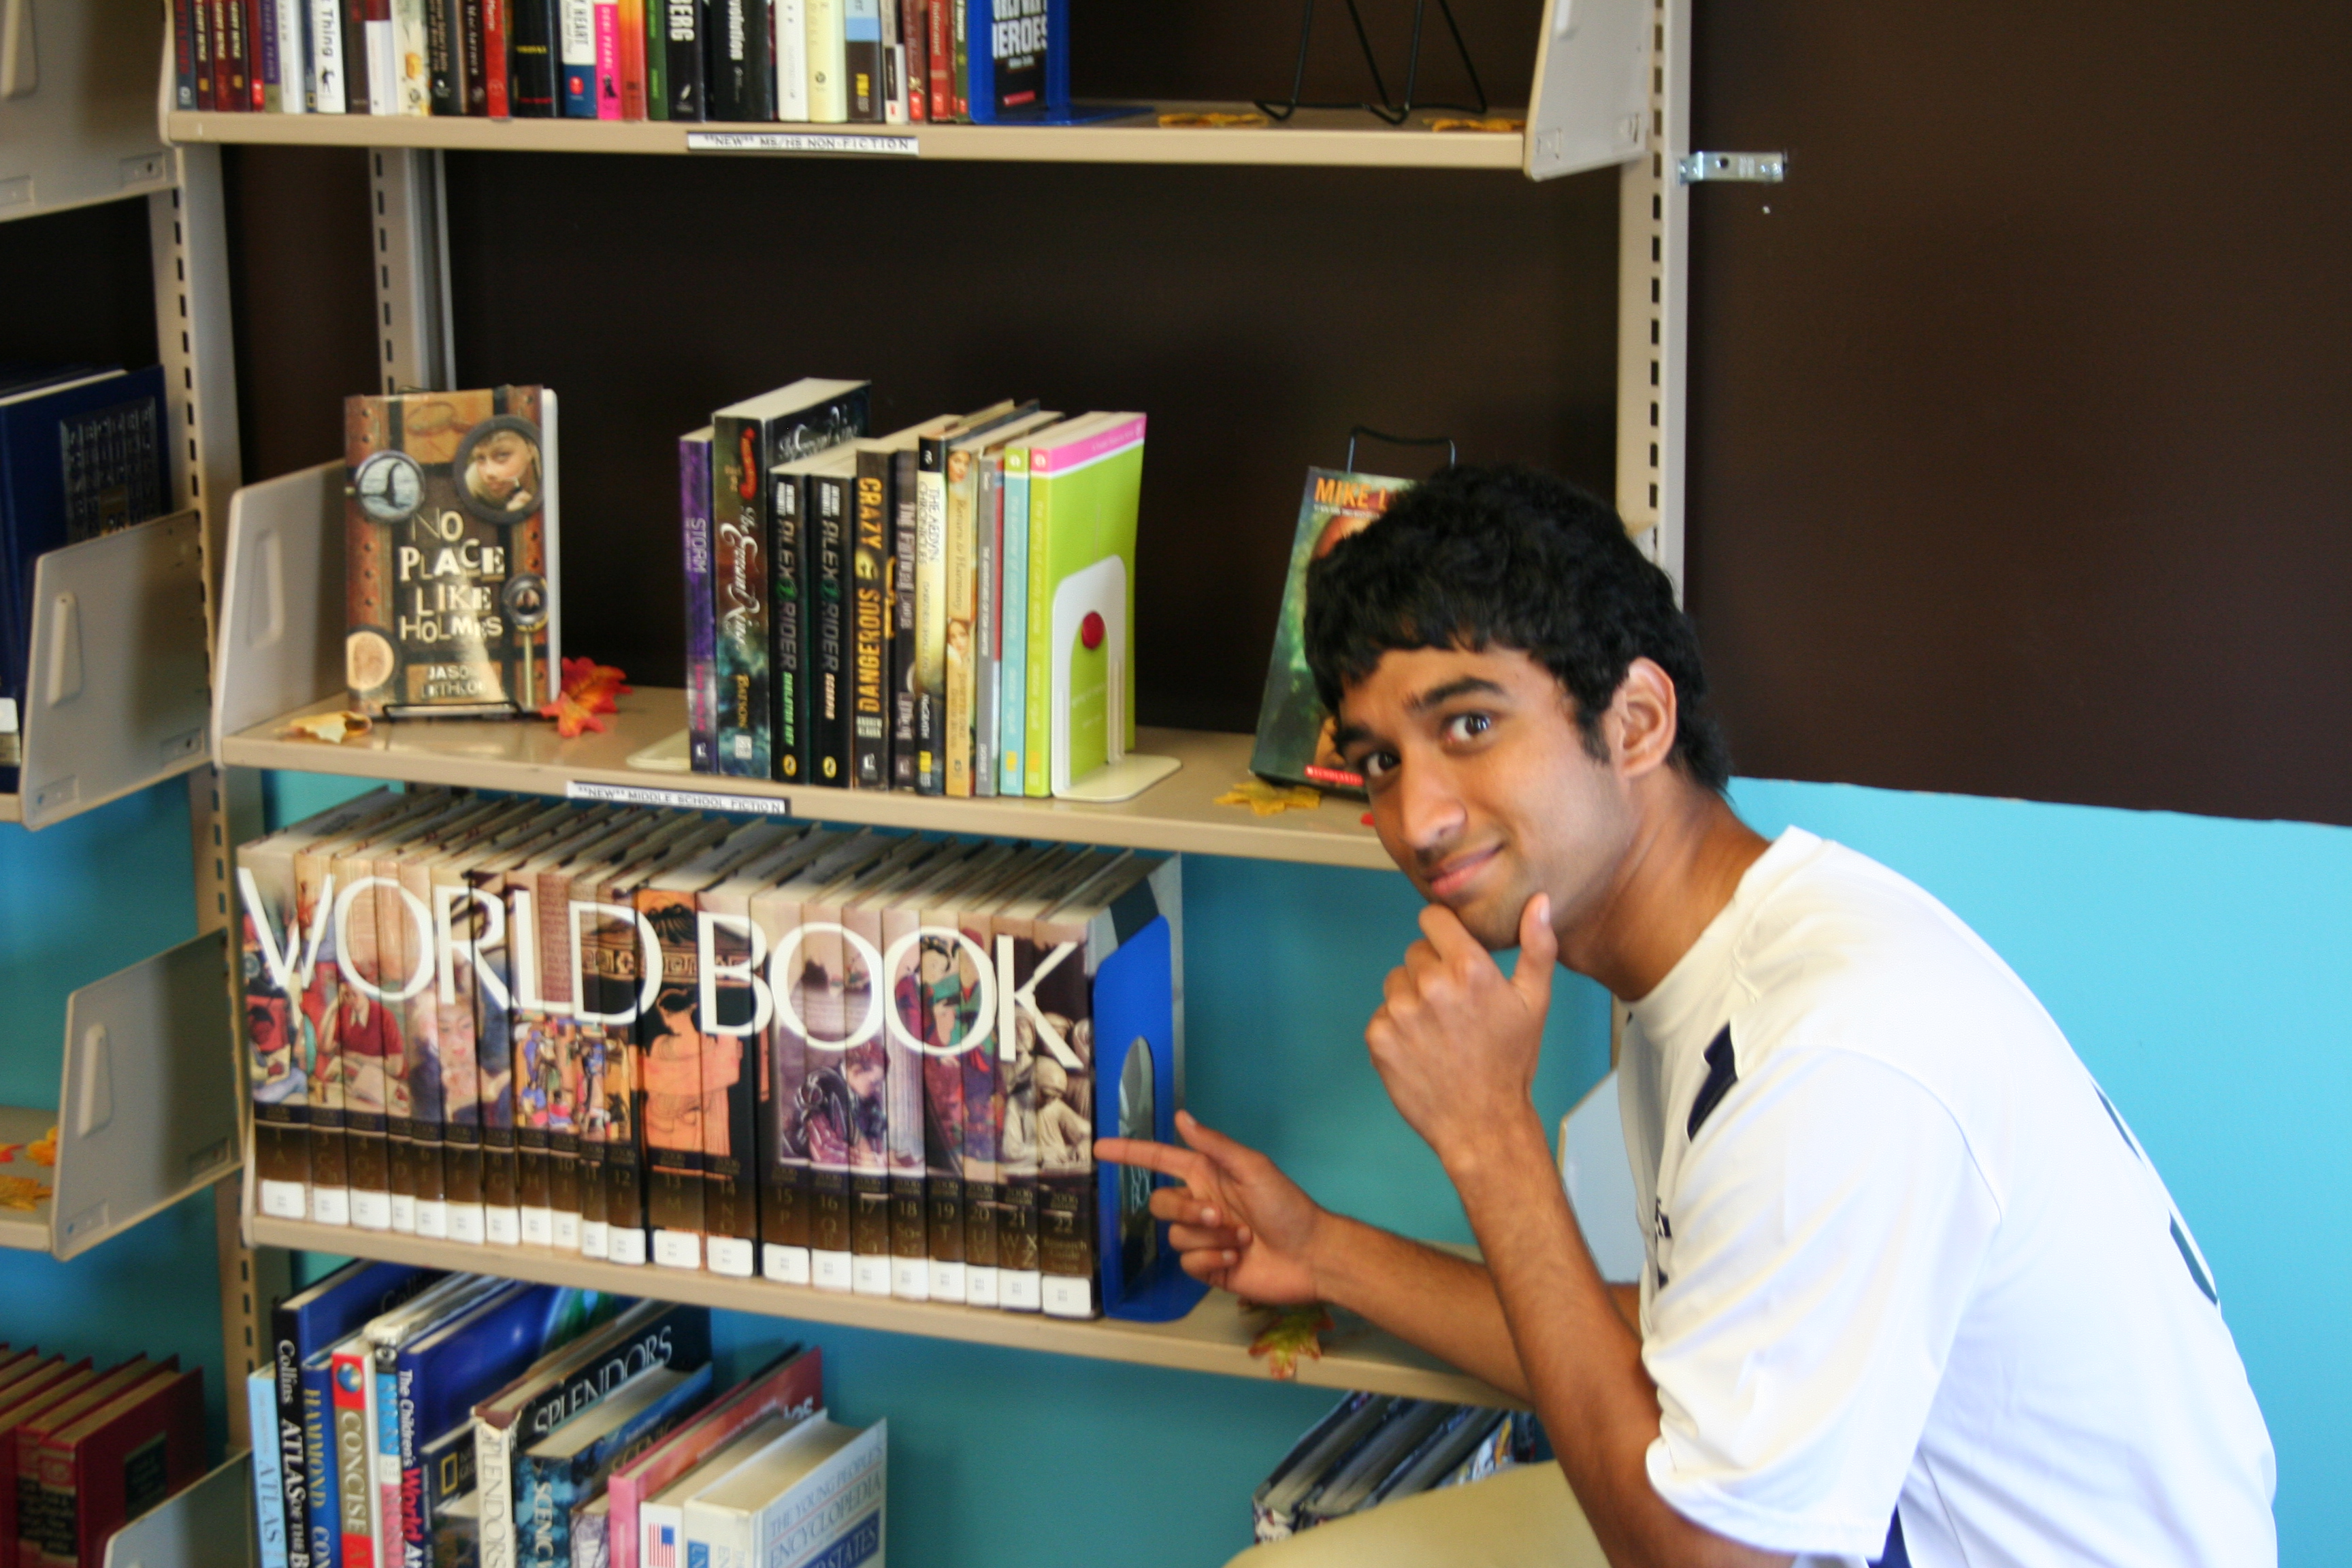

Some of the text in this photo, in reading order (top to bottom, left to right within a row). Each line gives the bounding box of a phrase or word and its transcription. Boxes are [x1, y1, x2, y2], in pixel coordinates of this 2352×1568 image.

[321, 9, 335, 57] Thing
[929, 488, 940, 514] THE
[1314, 477, 1372, 510] MIKE
[411, 507, 464, 542] NO
[399, 539, 505, 582] PLACE
[690, 517, 707, 574] STORM
[416, 586, 491, 617] LIKE
[777, 519, 797, 671] ALEX RIDER
[821, 519, 840, 672] ALEX RIDER
[859, 478, 882, 712] CRAZY DANGEROUS
[399, 616, 504, 643] HOLMES
[428, 665, 478, 681] JASO
[627, 789, 670, 804] MIDDLE
[677, 795, 723, 808] SCHOOL
[731, 800, 780, 812] FICTION
[237, 867, 1085, 1070] WORLD BOOK
[557, 1156, 575, 1173] 10
[615, 1169, 632, 1188] 12
[720, 1179, 736, 1196] 14
[777, 1188, 794, 1205] 15
[820, 1193, 839, 1211] 16
[860, 1196, 877, 1214] 17
[899, 1200, 919, 1218] 18
[936, 1201, 956, 1220] 19
[969, 1205, 991, 1224] 20
[1007, 1208, 1026, 1228] 21
[939, 1224, 951, 1242] T
[1053, 1213, 1074, 1235] 22
[278, 1339, 298, 1405] Collins
[399, 1370, 413, 1395] The
[535, 1324, 672, 1433] SPLENDORS
[304, 1388, 327, 1508] HAMMOND
[400, 1399, 416, 1467] Children's
[281, 1418, 306, 1501] ATLAS
[342, 1410, 366, 1534] CONCISE
[258, 1460, 283, 1543] ATLAS
[403, 1468, 423, 1541] World
[534, 1482, 554, 1558] SCENIC
[291, 1522, 304, 1552] THE
